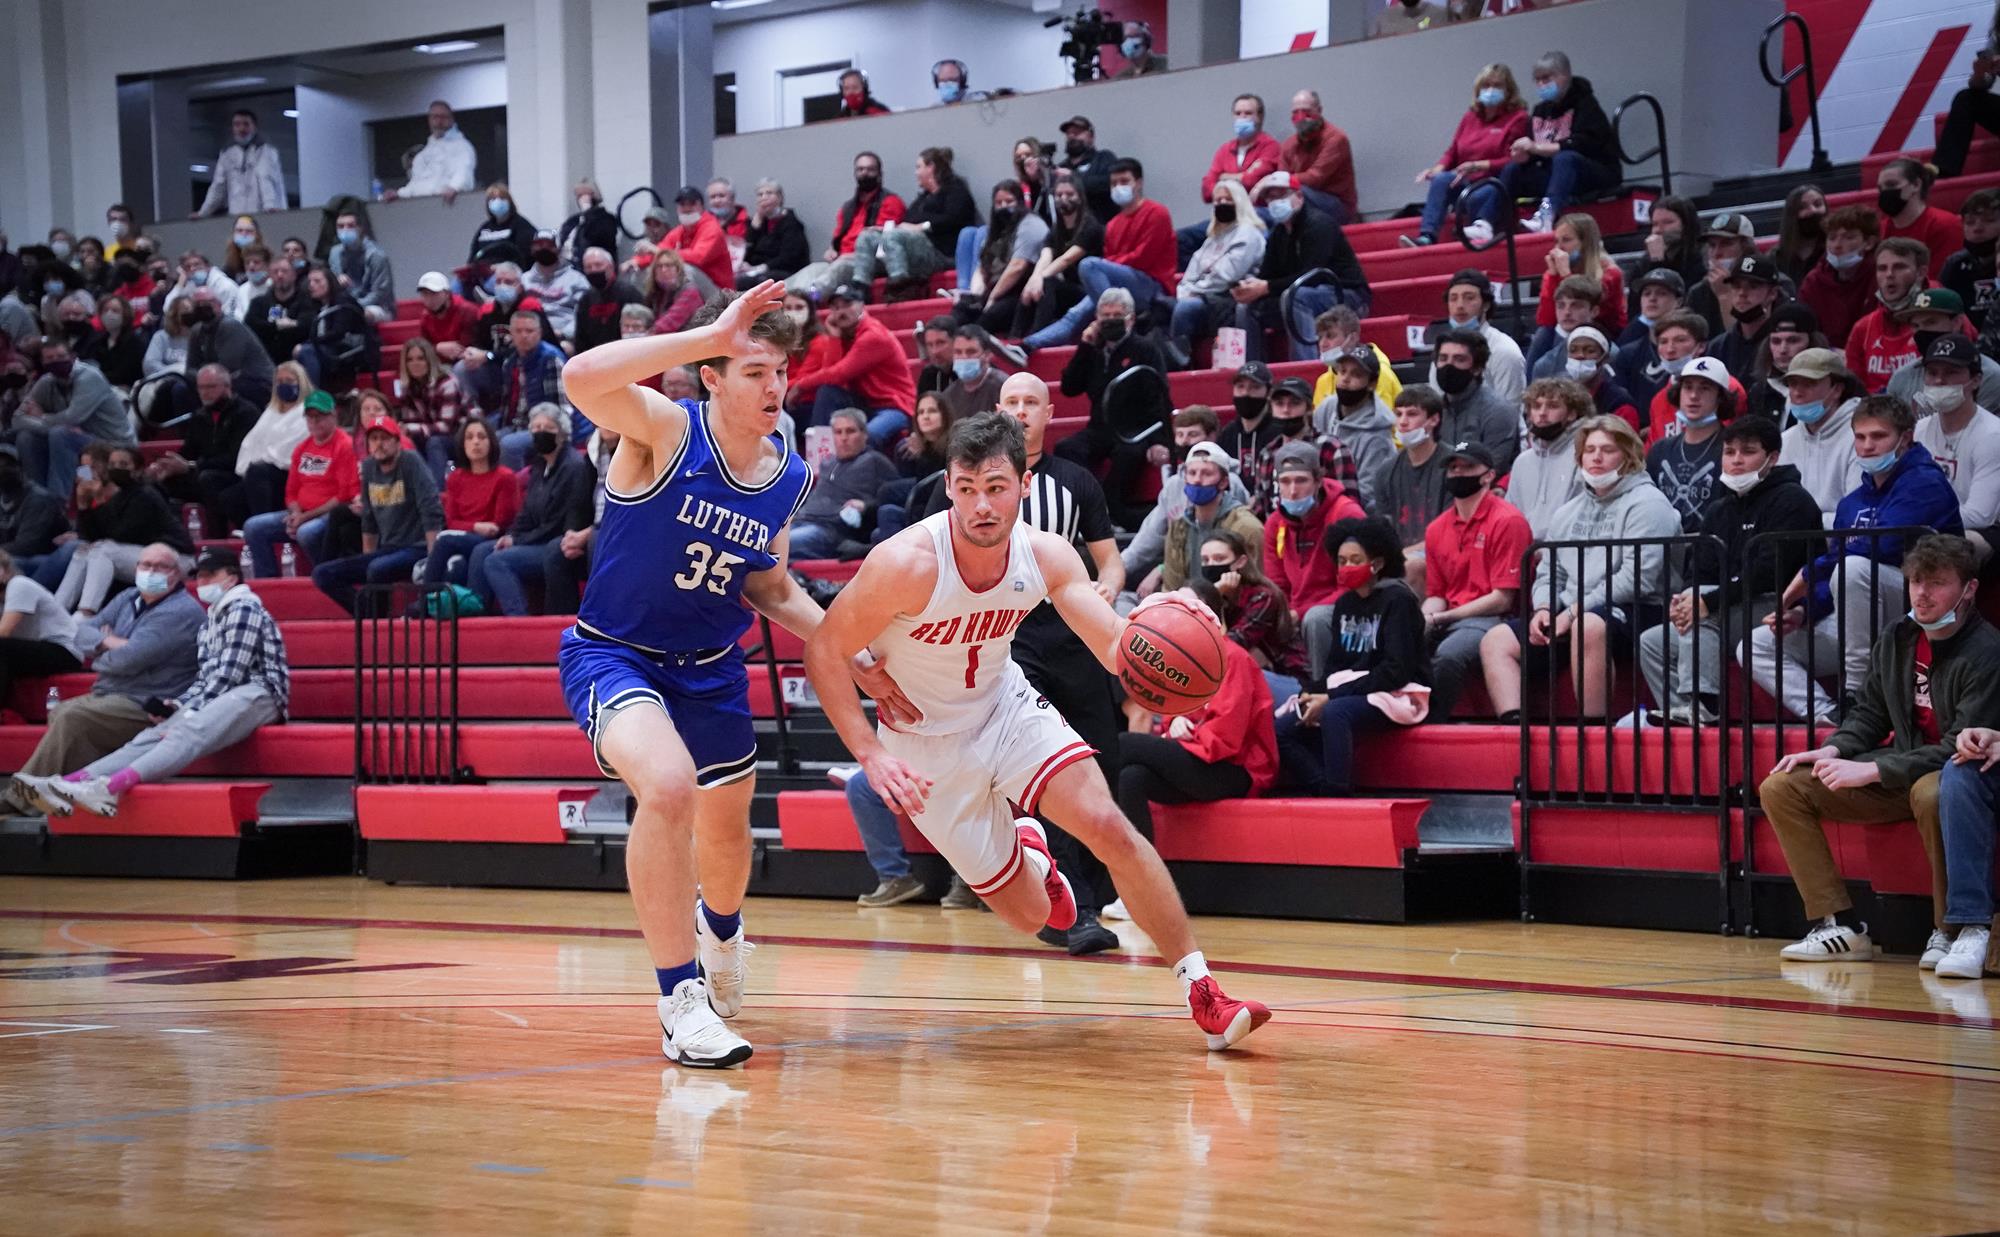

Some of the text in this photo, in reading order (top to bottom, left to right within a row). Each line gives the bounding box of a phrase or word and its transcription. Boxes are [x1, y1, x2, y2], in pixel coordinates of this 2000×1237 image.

[676, 494, 769, 552] LUTHER
[674, 541, 746, 596] 35
[909, 616, 962, 645] RED
[965, 644, 983, 689] 1
[1129, 632, 1190, 687] Wilson
[1121, 668, 1166, 707] NCAA
